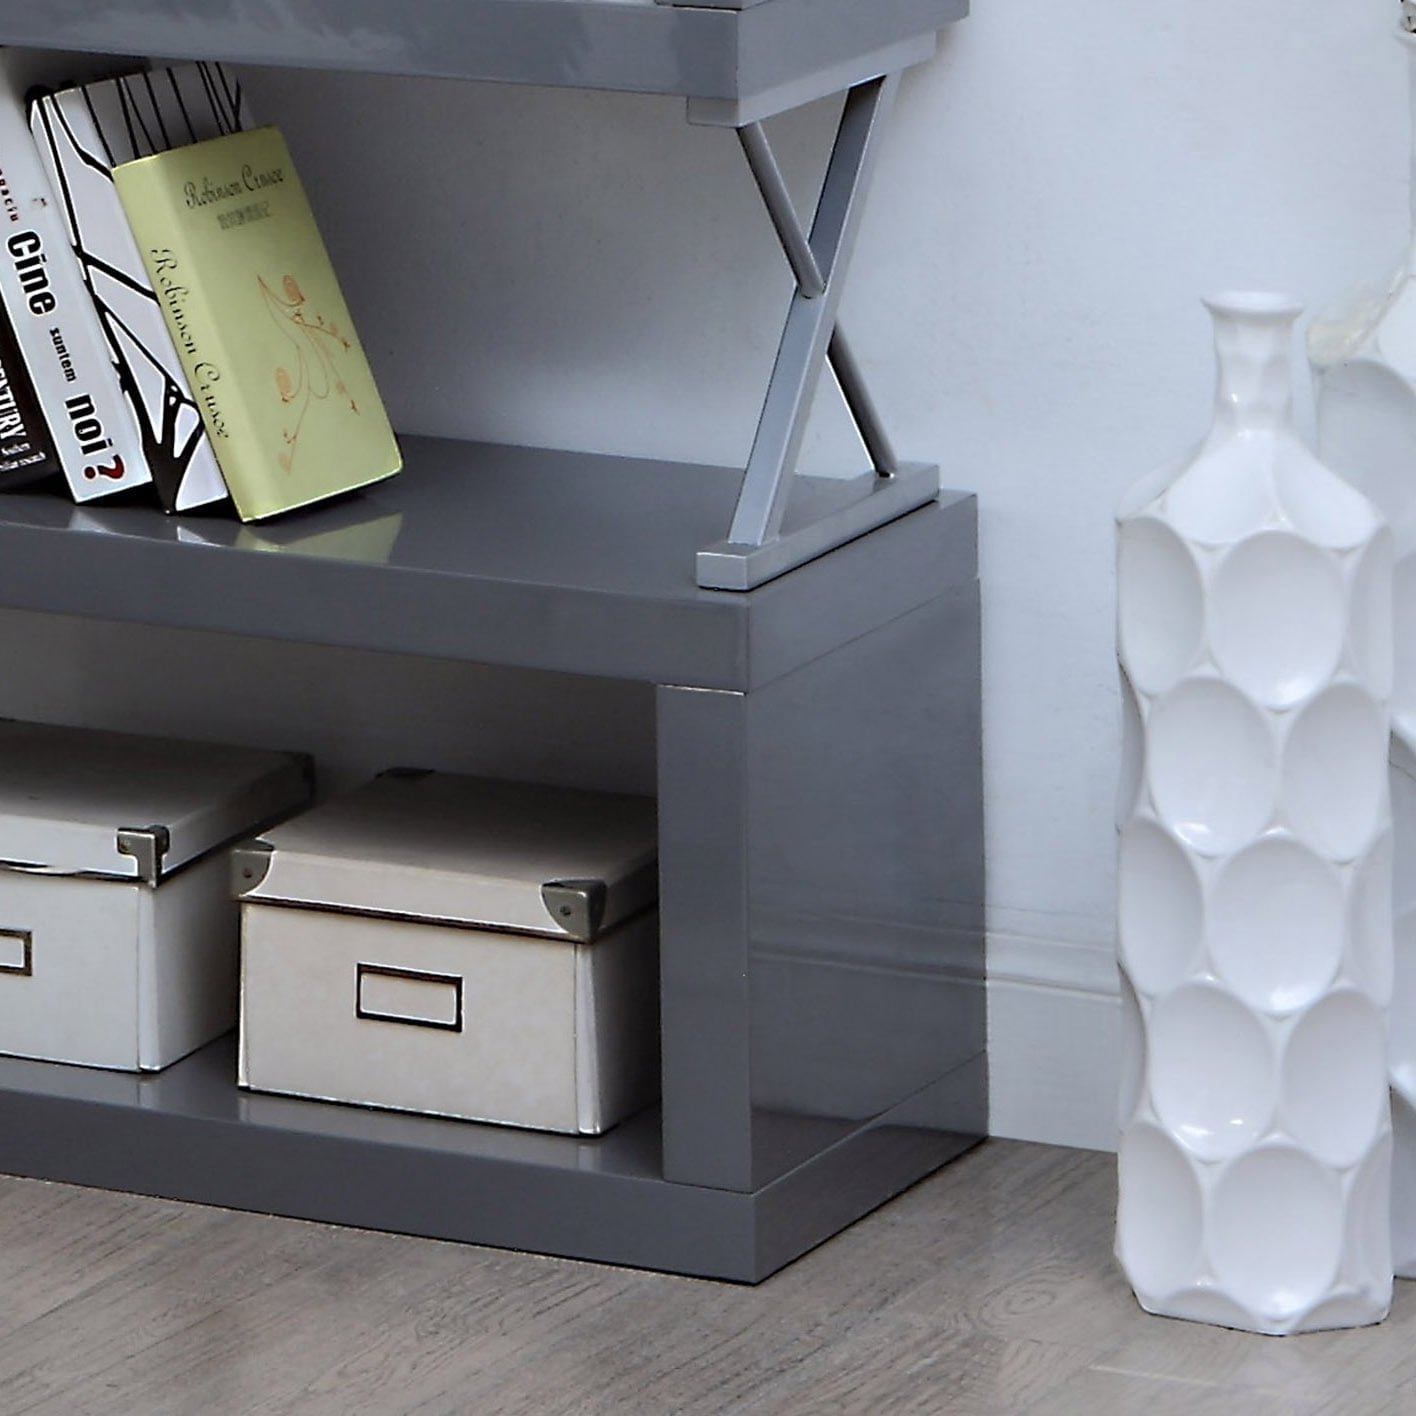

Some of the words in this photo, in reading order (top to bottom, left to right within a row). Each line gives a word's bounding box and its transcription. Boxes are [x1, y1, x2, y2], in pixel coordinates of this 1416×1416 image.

[7, 229, 58, 318] Cine
[48, 326, 77, 383] suntem
[149, 246, 200, 362] Robinson
[191, 358, 232, 440] Crusoe
